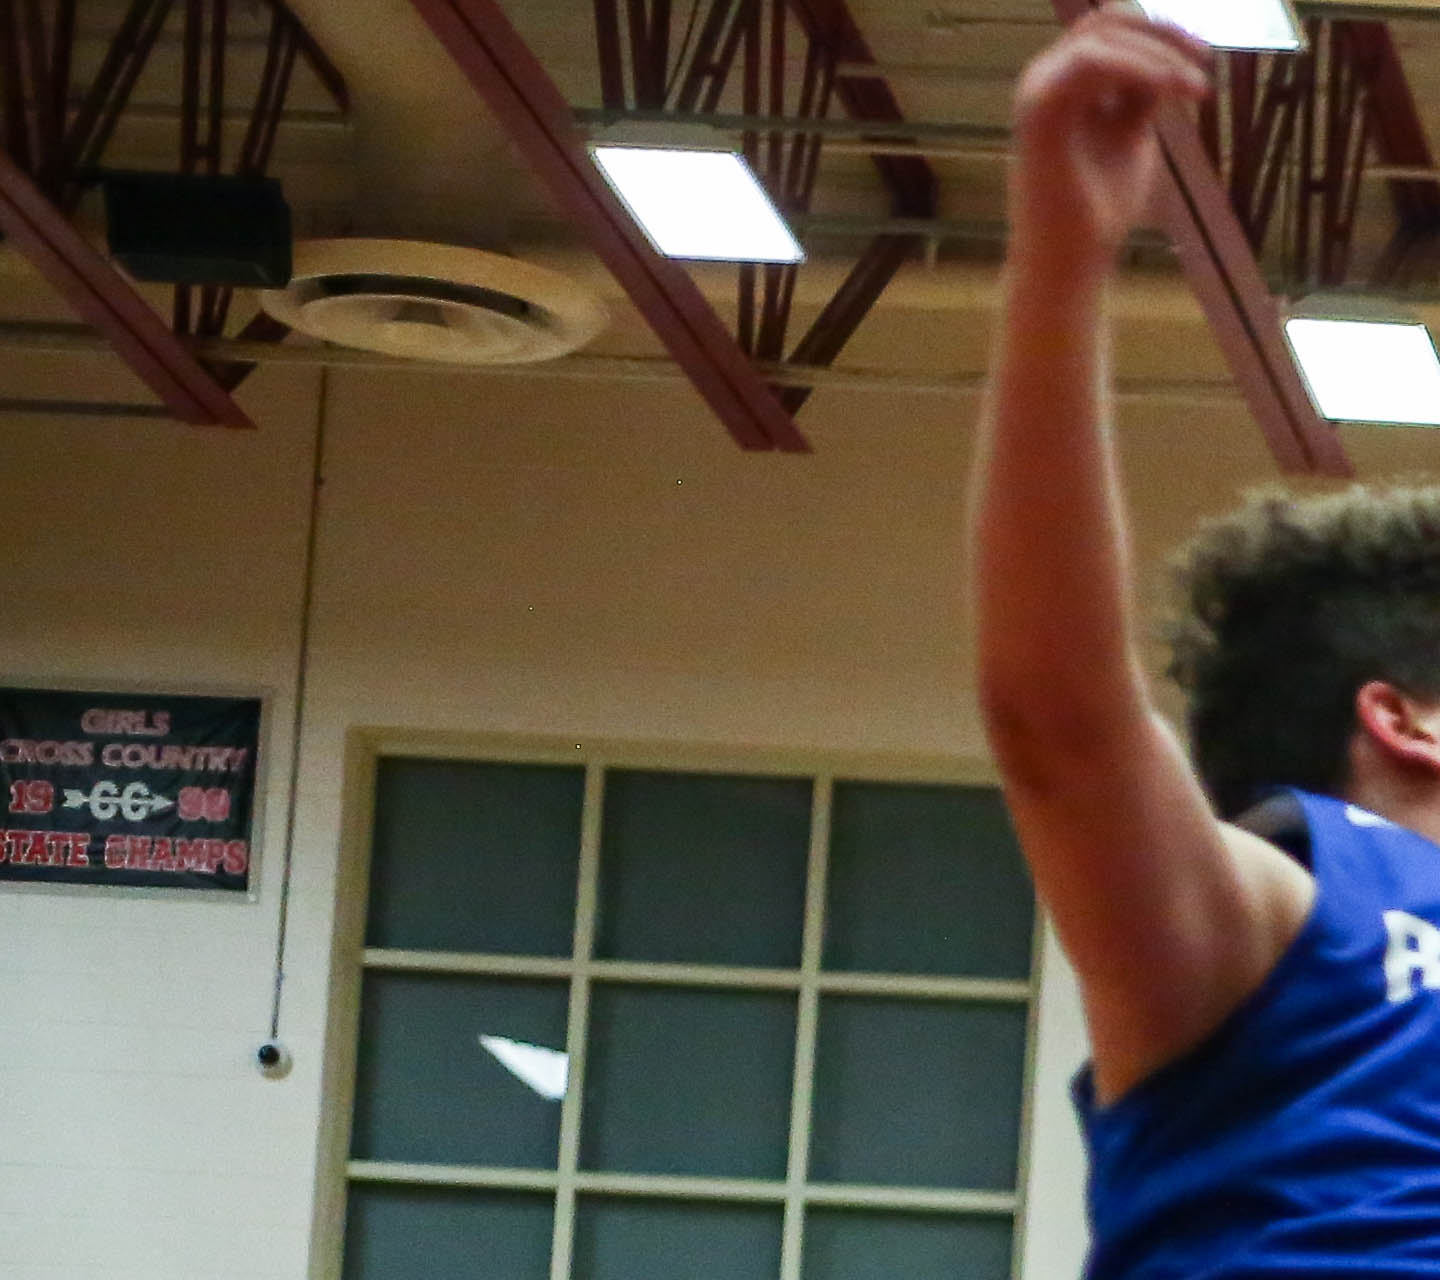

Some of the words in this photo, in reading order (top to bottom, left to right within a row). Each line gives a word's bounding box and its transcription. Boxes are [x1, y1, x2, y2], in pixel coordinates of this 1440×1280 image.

[81, 708, 170, 736] GIRLS
[0, 738, 95, 766] CROSS
[102, 743, 247, 771] COUNTRY
[8, 780, 54, 814] 19
[105, 834, 248, 874] CHAMPS
